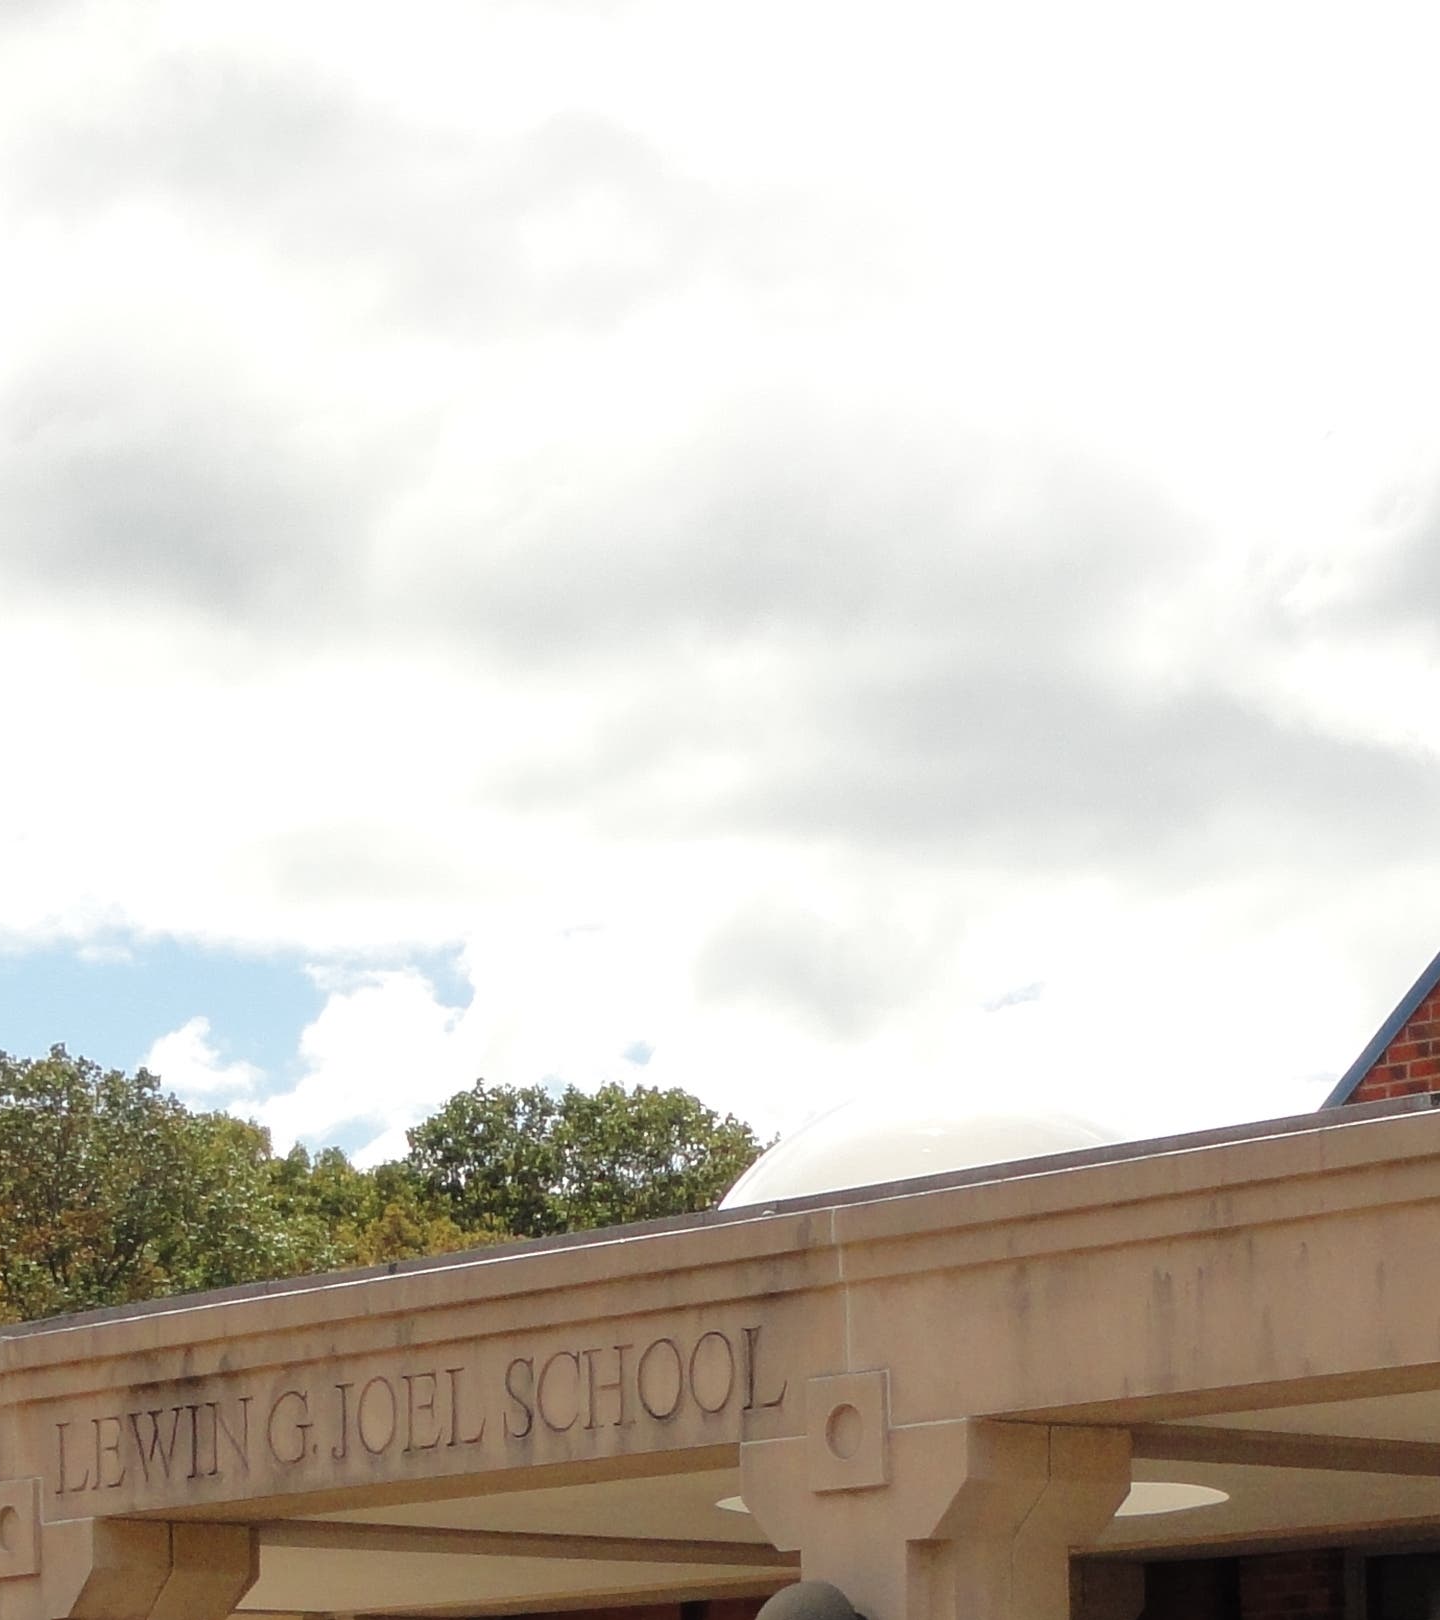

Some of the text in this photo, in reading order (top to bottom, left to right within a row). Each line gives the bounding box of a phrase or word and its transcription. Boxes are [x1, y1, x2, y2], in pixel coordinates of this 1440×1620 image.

[56, 1325, 787, 1495] LEWIN G. JOEL SCHOOL
